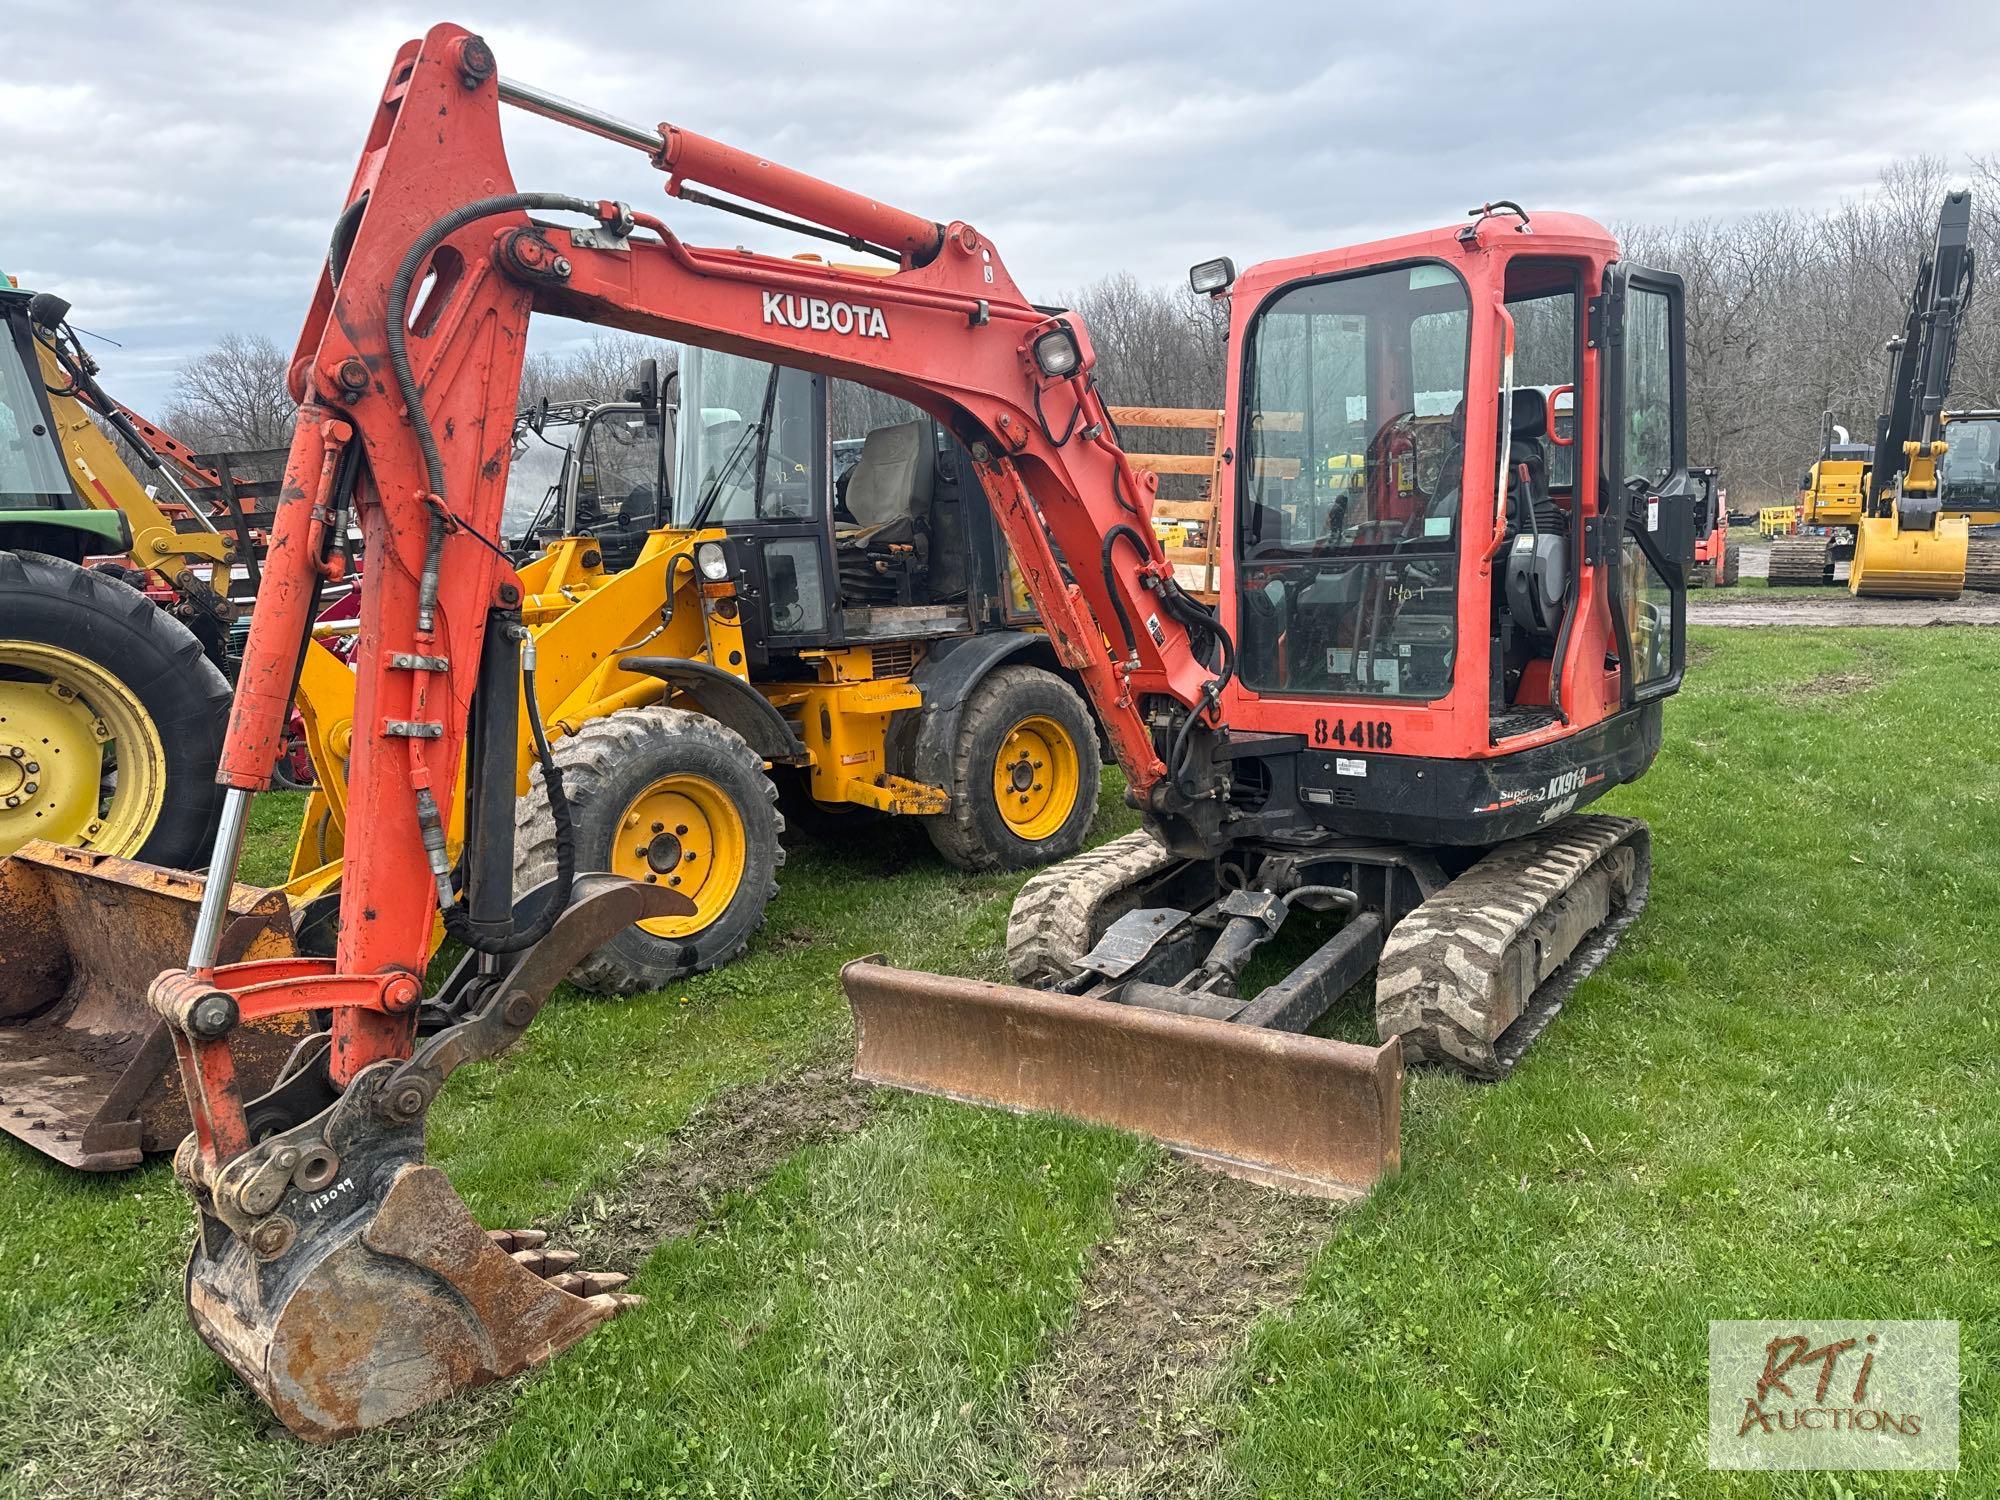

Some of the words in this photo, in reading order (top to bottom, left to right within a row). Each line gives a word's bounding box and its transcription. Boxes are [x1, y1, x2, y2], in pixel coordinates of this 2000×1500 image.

[761, 290, 890, 339] KUBOTA
[1314, 718, 1393, 749] 84418
[1499, 788, 1531, 801] Super
[1515, 792, 1540, 806] Series
[1547, 766, 1587, 800] KX91-3
[310, 1177, 355, 1213] 113099
